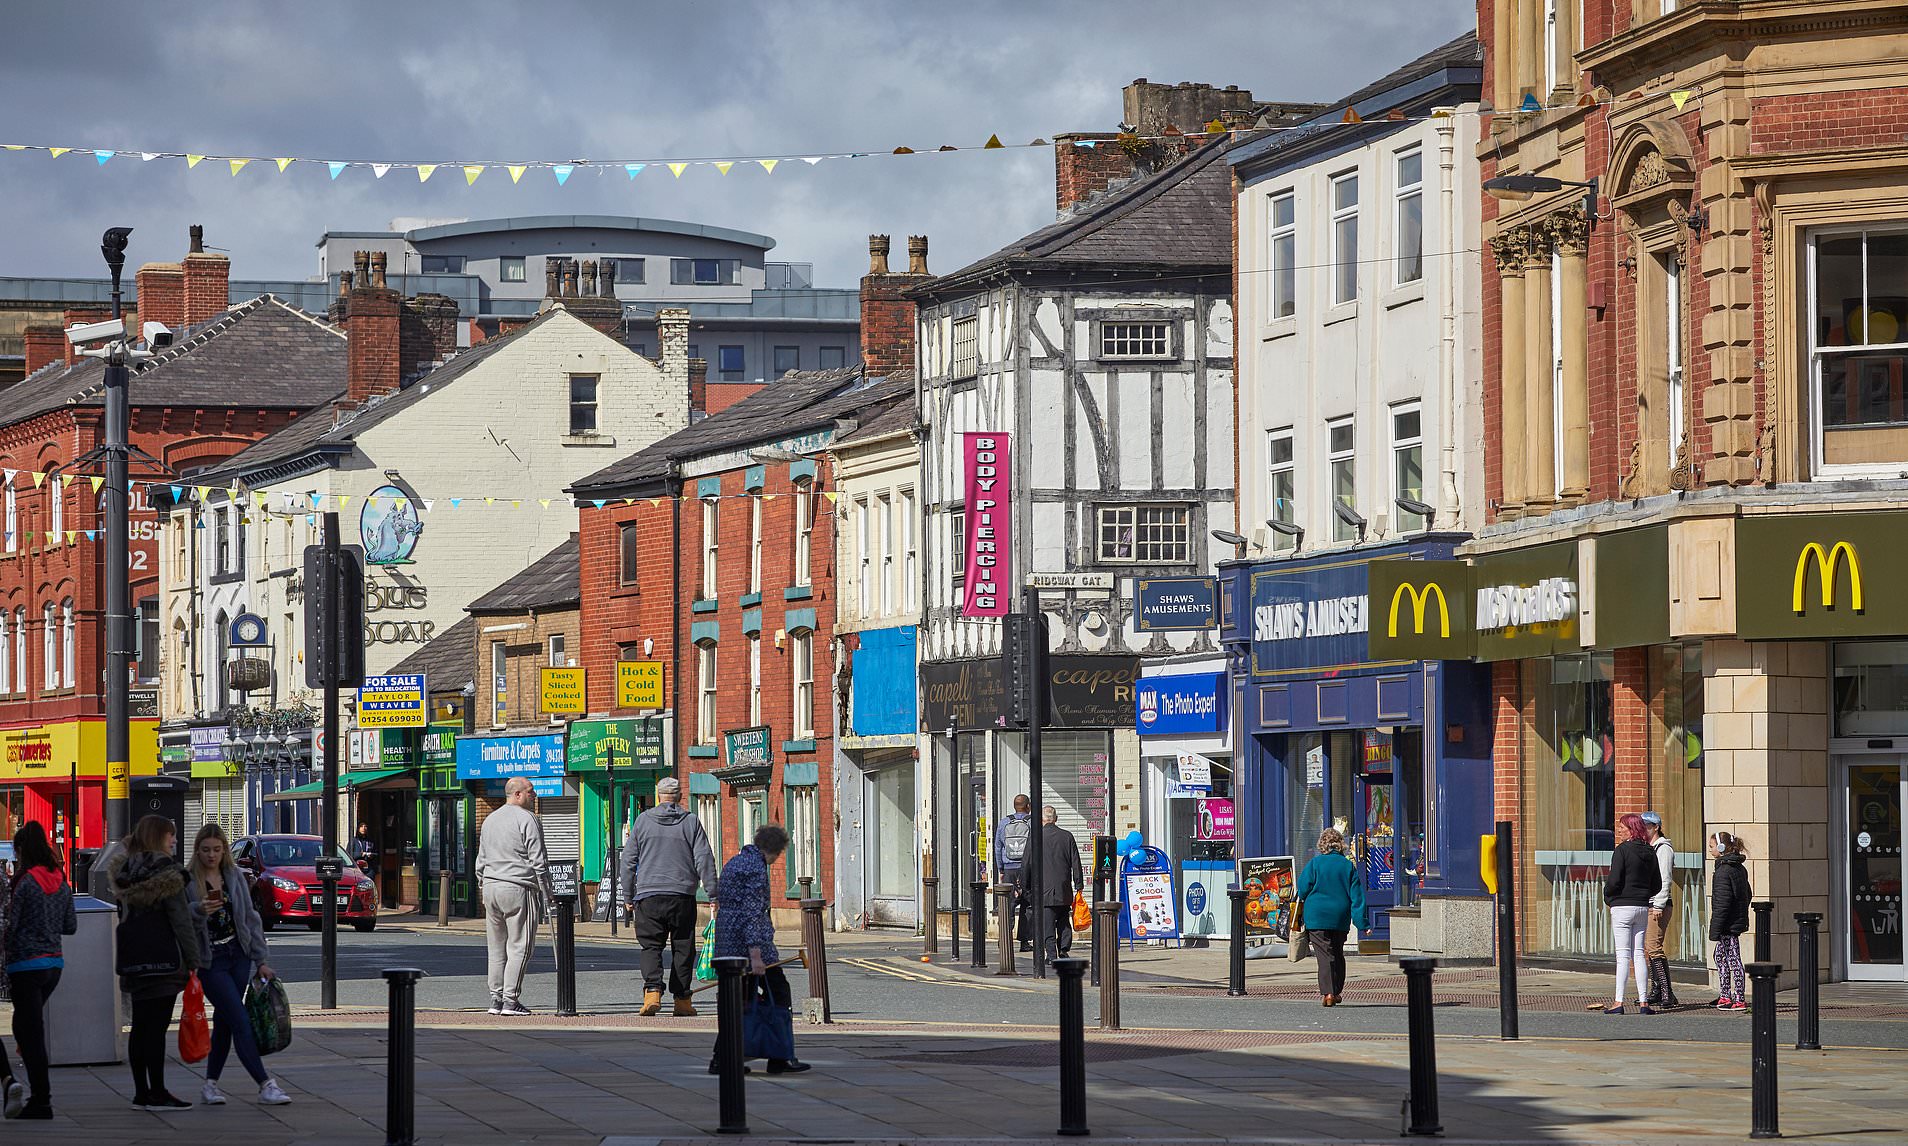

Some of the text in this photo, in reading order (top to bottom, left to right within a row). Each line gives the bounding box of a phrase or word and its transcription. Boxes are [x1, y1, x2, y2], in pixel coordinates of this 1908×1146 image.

[976, 438, 997, 608] BODY PIERCING
[1160, 595, 1195, 604] SHAWS
[1143, 604, 1212, 614] AMUSEMENTS
[1254, 595, 1369, 641] SHAWS AMUSEM
[550, 672, 575, 680] Tasty
[621, 666, 659, 676] Hot &
[365, 676, 417, 687] FOR SALE
[1052, 660, 1141, 694] capel
[625, 680, 655, 689] Cold
[544, 691, 581, 699] Cooked
[625, 693, 656, 703] Food
[370, 701, 413, 709] WEAVER
[548, 701, 577, 709] Meats
[1140, 691, 1157, 710] MAX
[1161, 691, 1217, 720] The Photo Expert
[605, 723, 619, 735] THE
[383, 746, 412, 754] HEALTH
[594, 736, 631, 756] BUTTERY
[481, 740, 541, 764] Furniture & Carpets
[384, 754, 404, 762] RACK
[1135, 887, 1165, 895] SCHOOL
[1188, 887, 1204, 898] PHOTO
